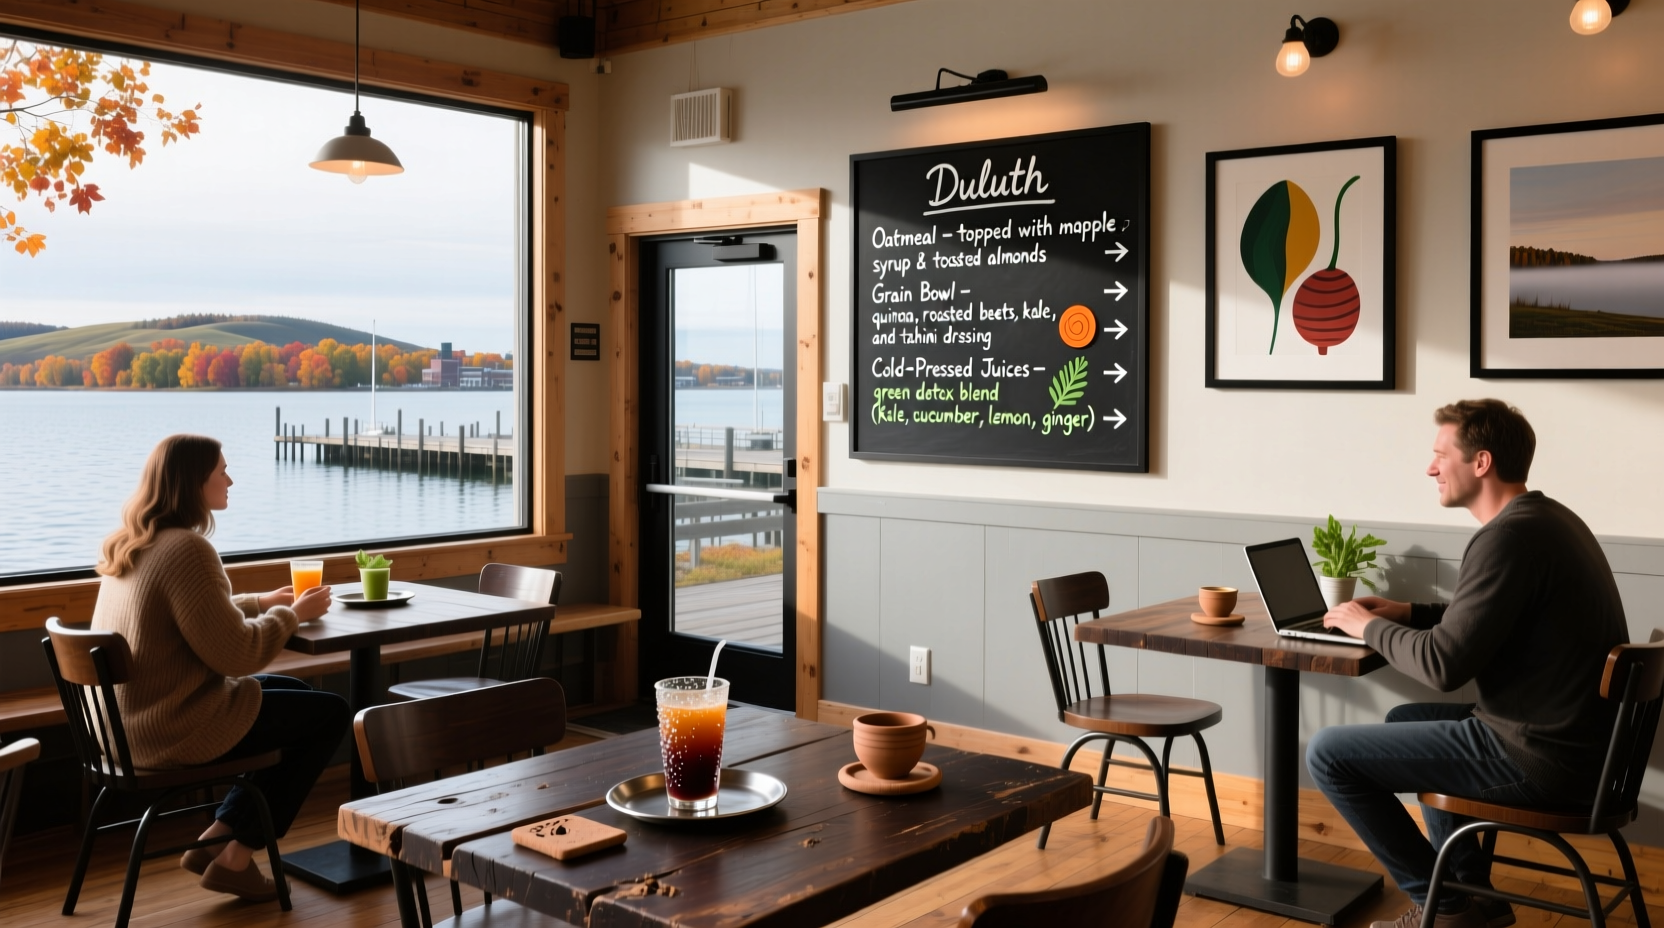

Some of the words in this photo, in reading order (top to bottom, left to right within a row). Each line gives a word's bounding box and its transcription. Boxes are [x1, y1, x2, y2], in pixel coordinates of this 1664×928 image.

[925, 155, 1049, 207] Duluth
[872, 225, 937, 249] Oatmeal
[955, 218, 1012, 247] topped
[1018, 214, 1053, 239] with
[1058, 210, 1117, 243] mapple
[872, 257, 911, 281] syrup
[916, 251, 927, 271] &
[987, 242, 1047, 266] almonds
[872, 282, 913, 304] Grain
[920, 281, 956, 302] Bowl
[922, 302, 973, 323] roasted
[979, 301, 1019, 323] beets,
[1022, 298, 1057, 322] kale,
[871, 327, 896, 345] and
[942, 325, 992, 350] drssing
[871, 356, 973, 378] Cold-Pressed
[980, 357, 1030, 378] Juices
[873, 387, 911, 405] green
[959, 381, 1000, 402] blend
[912, 404, 985, 430] cucumber,
[988, 404, 1037, 430] lemon,
[1041, 404, 1096, 436] ginger)
